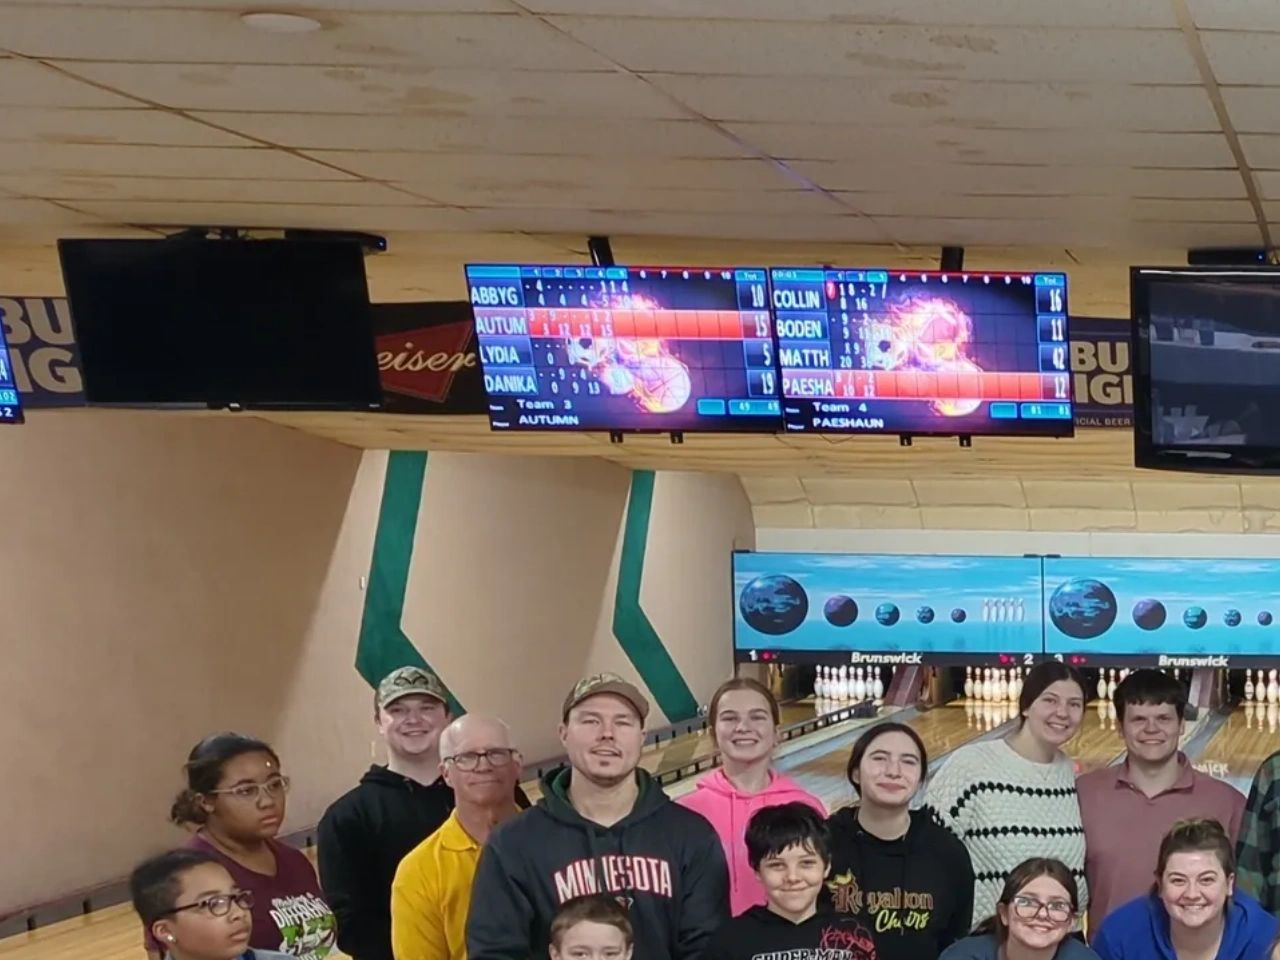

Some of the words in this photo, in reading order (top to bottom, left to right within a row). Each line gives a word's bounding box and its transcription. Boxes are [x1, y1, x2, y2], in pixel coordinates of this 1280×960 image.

[470, 286, 519, 306] ABBYG
[750, 284, 764, 308] 10
[774, 290, 820, 309] COLLIN
[1049, 288, 1062, 312] 16
[475, 314, 528, 335] AUTUM
[754, 314, 768, 338] 15
[777, 319, 823, 338] BODEN
[1051, 318, 1064, 342] 11
[480, 345, 521, 364] LYDIA
[762, 342, 772, 366] 5
[779, 349, 830, 368] MATTH
[484, 374, 539, 394] DANIKA
[760, 372, 775, 396] 19
[782, 378, 836, 397] PAESHA
[1054, 376, 1067, 399] 12
[516, 398, 554, 410] Team
[564, 399, 572, 410] 3
[812, 402, 850, 413] Team
[858, 402, 868, 413] 4
[518, 414, 580, 426] AUTUMN
[812, 417, 884, 430] PAESHAUN
[750, 650, 758, 661] 1
[851, 652, 923, 665] Brunswick
[1024, 653, 1034, 665] 2
[1158, 654, 1229, 668] Brunswick
